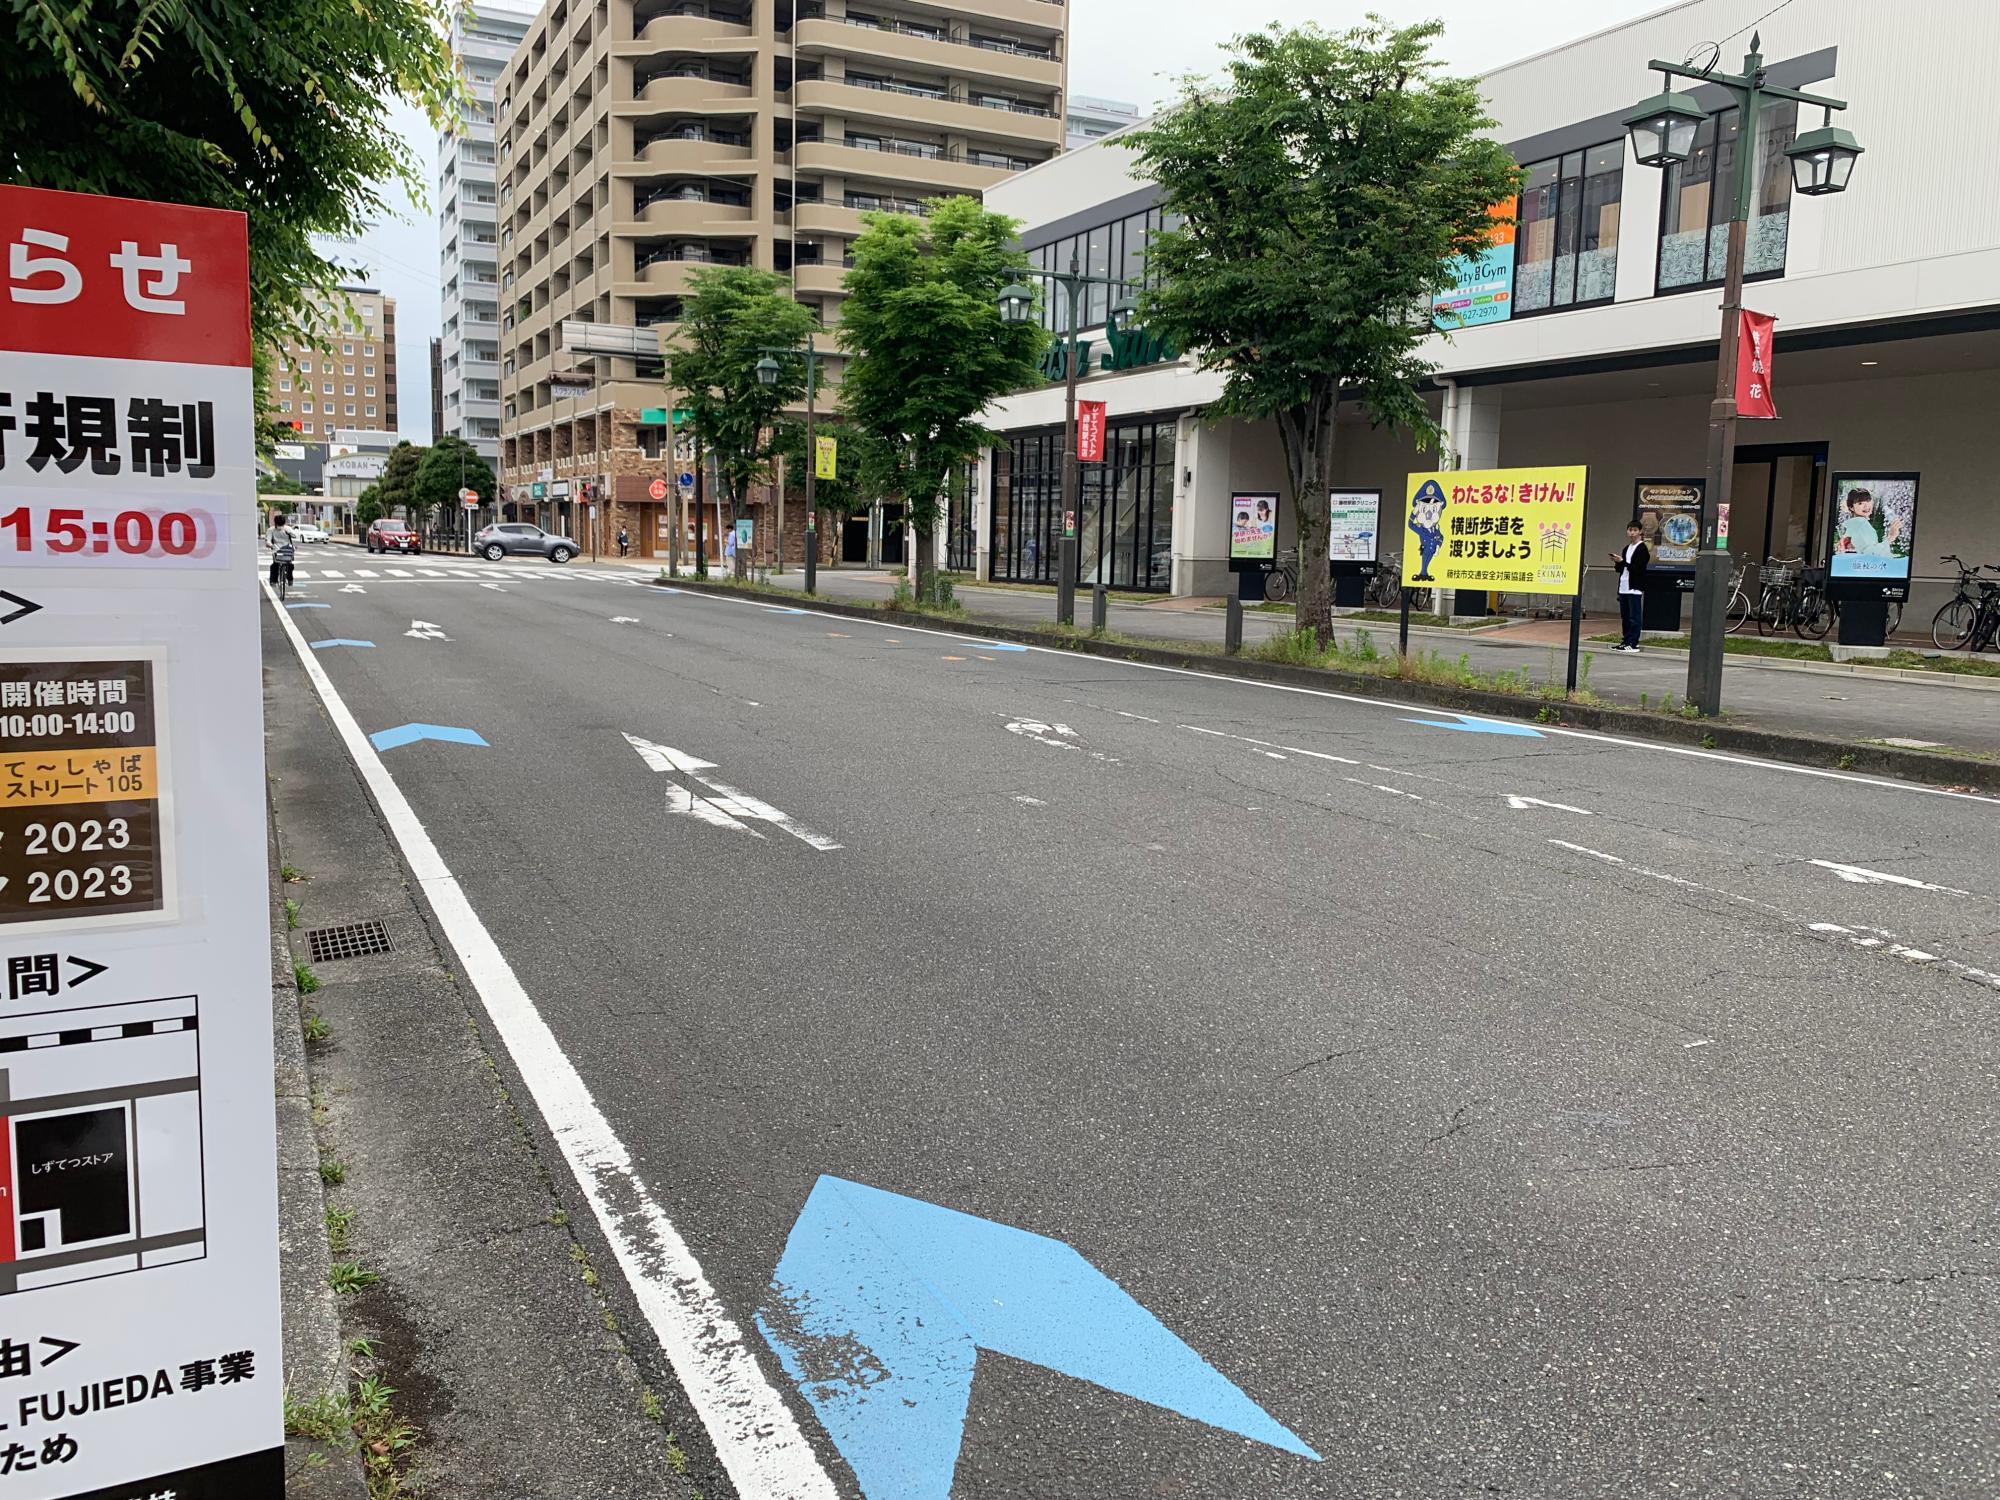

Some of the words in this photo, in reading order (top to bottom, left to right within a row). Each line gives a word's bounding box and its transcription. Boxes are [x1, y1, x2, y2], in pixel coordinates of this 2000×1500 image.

[9, 227, 192, 315] らせ
[1749, 384, 1761, 399] 花
[0, 391, 216, 479] 規制
[340, 460, 368, 470] KOBAN
[1451, 516, 1524, 536] 横断歩道を
[1449, 539, 1531, 560] 渡りましょう
[1537, 570, 1567, 578] EKINAN
[1, 679, 128, 707] 開催時間
[0, 711, 135, 738] 10:00-14:00
[7, 781, 99, 798] ストリート
[106, 774, 143, 793] 105
[24, 818, 130, 855] 2023
[28, 865, 133, 903] 2023
[31, 1152, 114, 1175] しずてつストア
[19, 1368, 174, 1427] FUJIEDA
[180, 1349, 255, 1393] 事業
[0, 1433, 79, 1476] ため
